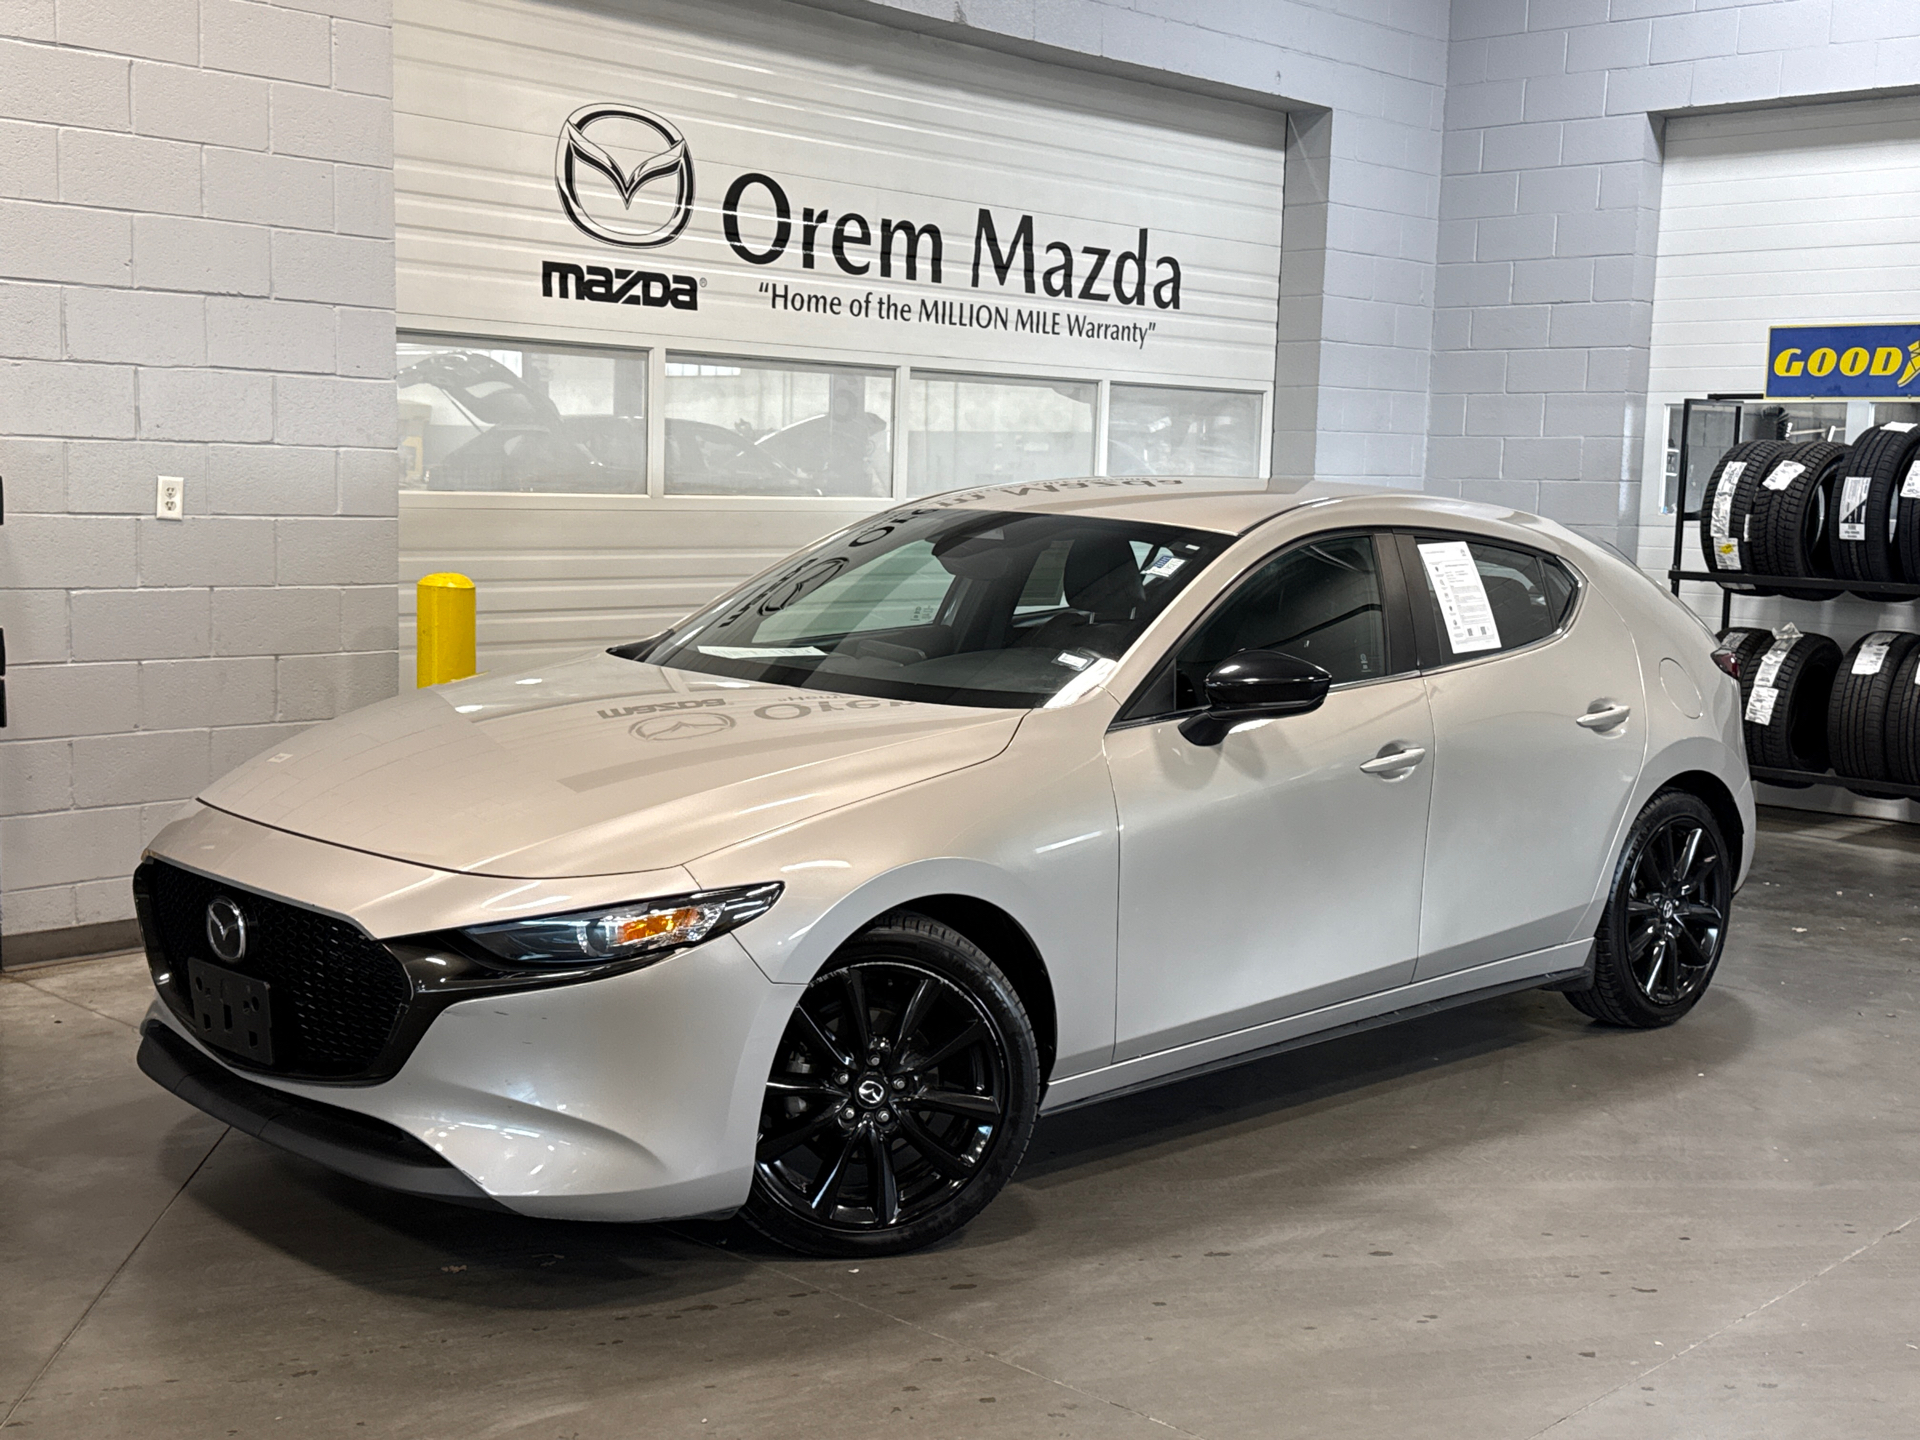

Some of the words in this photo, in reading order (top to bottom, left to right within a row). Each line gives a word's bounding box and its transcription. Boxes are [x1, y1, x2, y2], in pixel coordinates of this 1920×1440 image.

[722, 172, 943, 284] Orem
[971, 207, 1182, 310] Mazda
[849, 290, 873, 318] of
[877, 297, 912, 322] the
[918, 299, 1008, 331] MILLION
[1015, 308, 1060, 336] MILE
